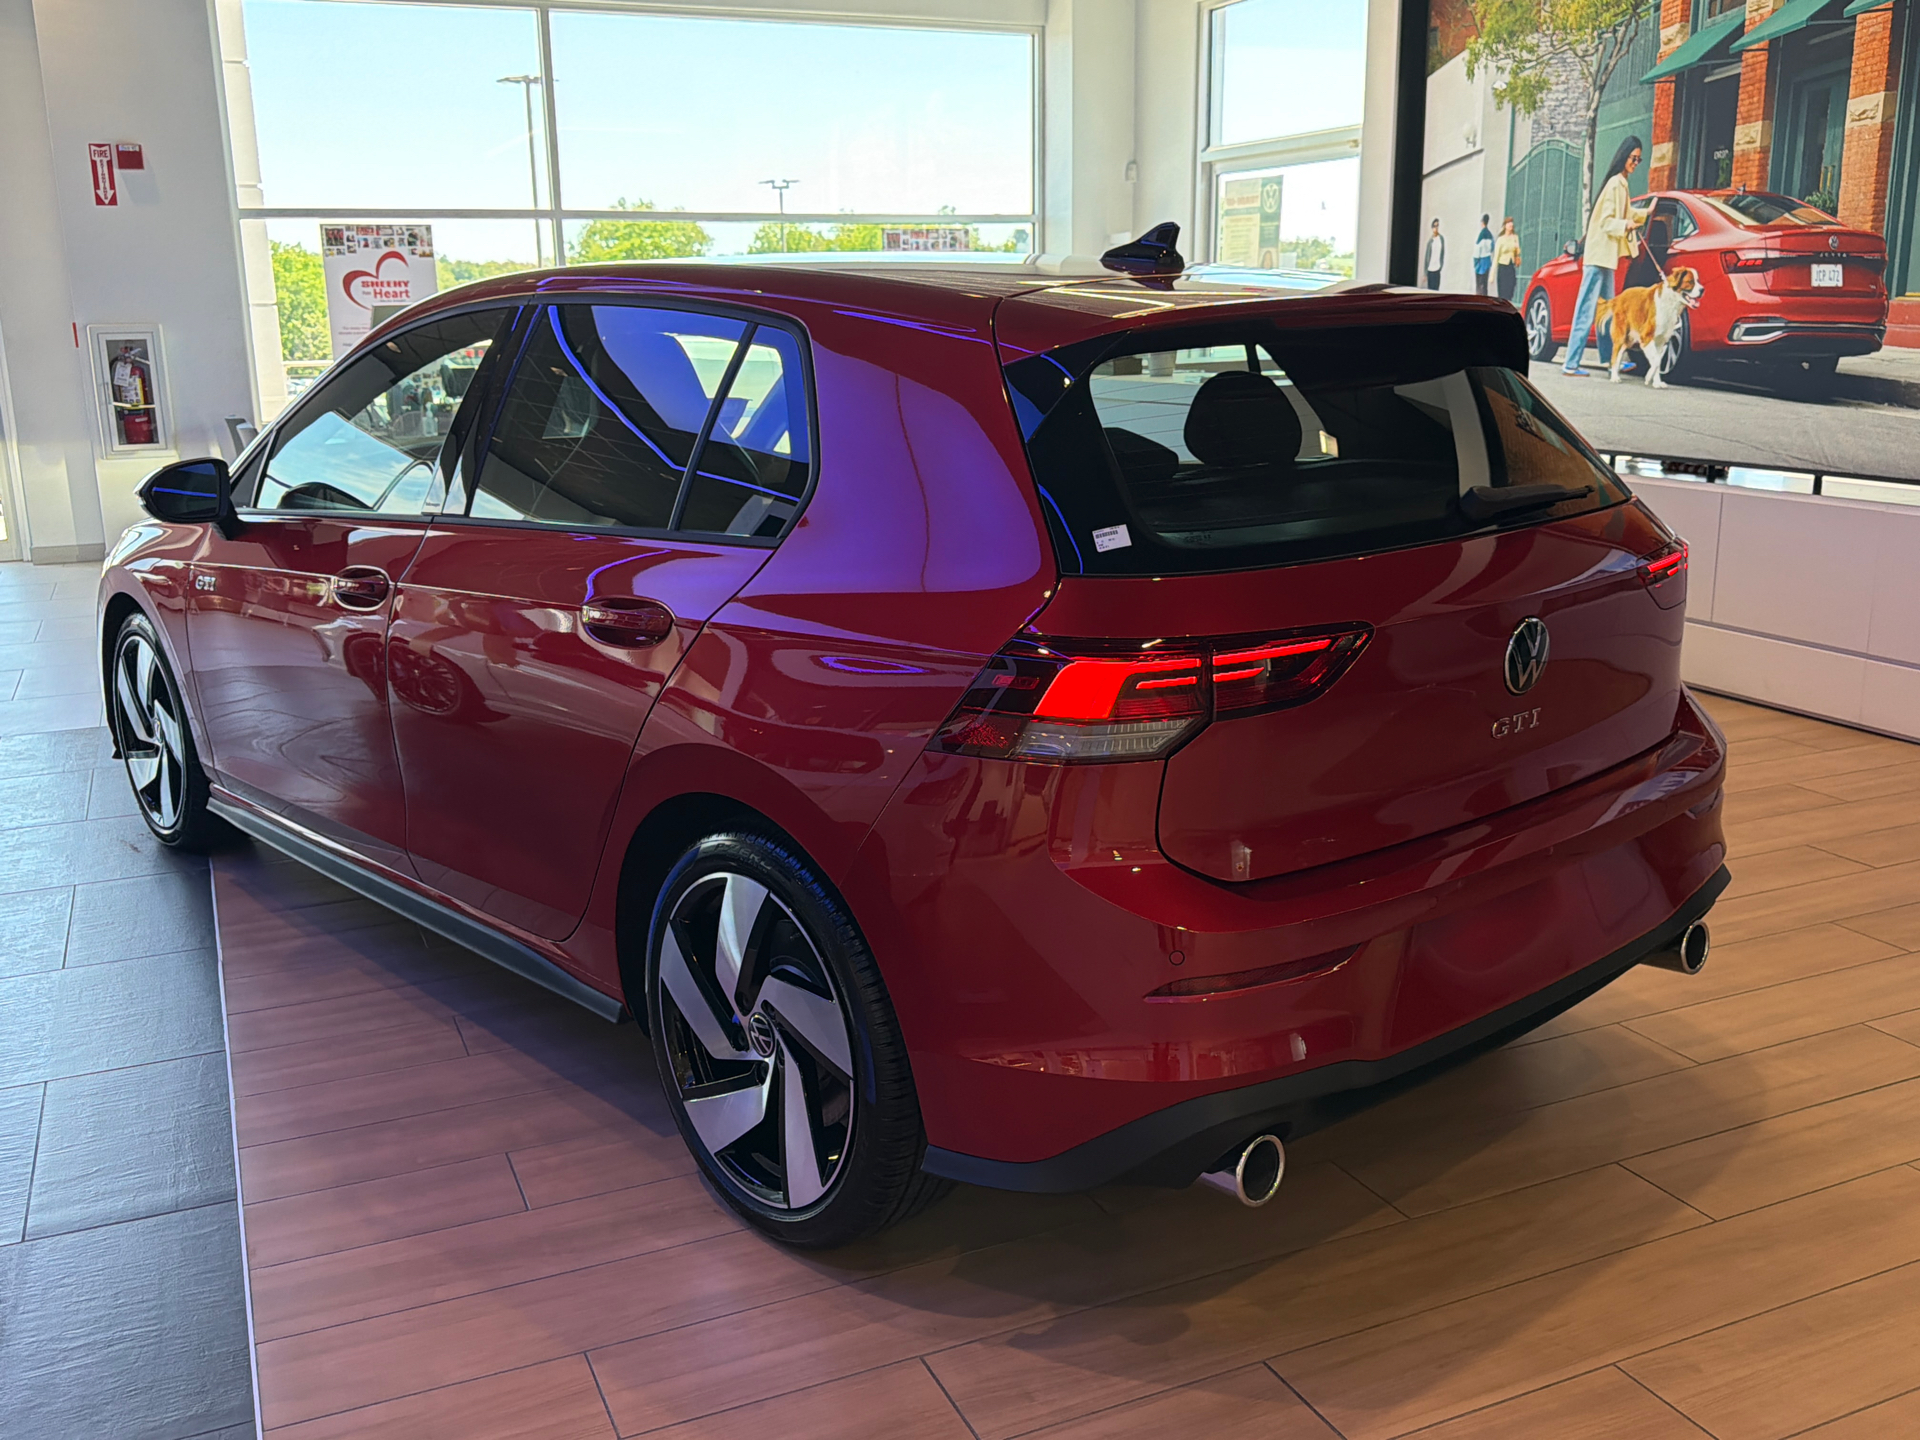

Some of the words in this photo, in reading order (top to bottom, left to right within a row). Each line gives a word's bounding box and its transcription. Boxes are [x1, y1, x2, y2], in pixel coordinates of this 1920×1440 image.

[93, 149, 109, 158] FIRE
[1815, 269, 1826, 282] JCP
[1829, 269, 1840, 282] 472
[361, 280, 410, 288] SHEEHY
[373, 288, 411, 299] Heart
[195, 575, 217, 591] GTI
[1491, 707, 1541, 739] GTI
